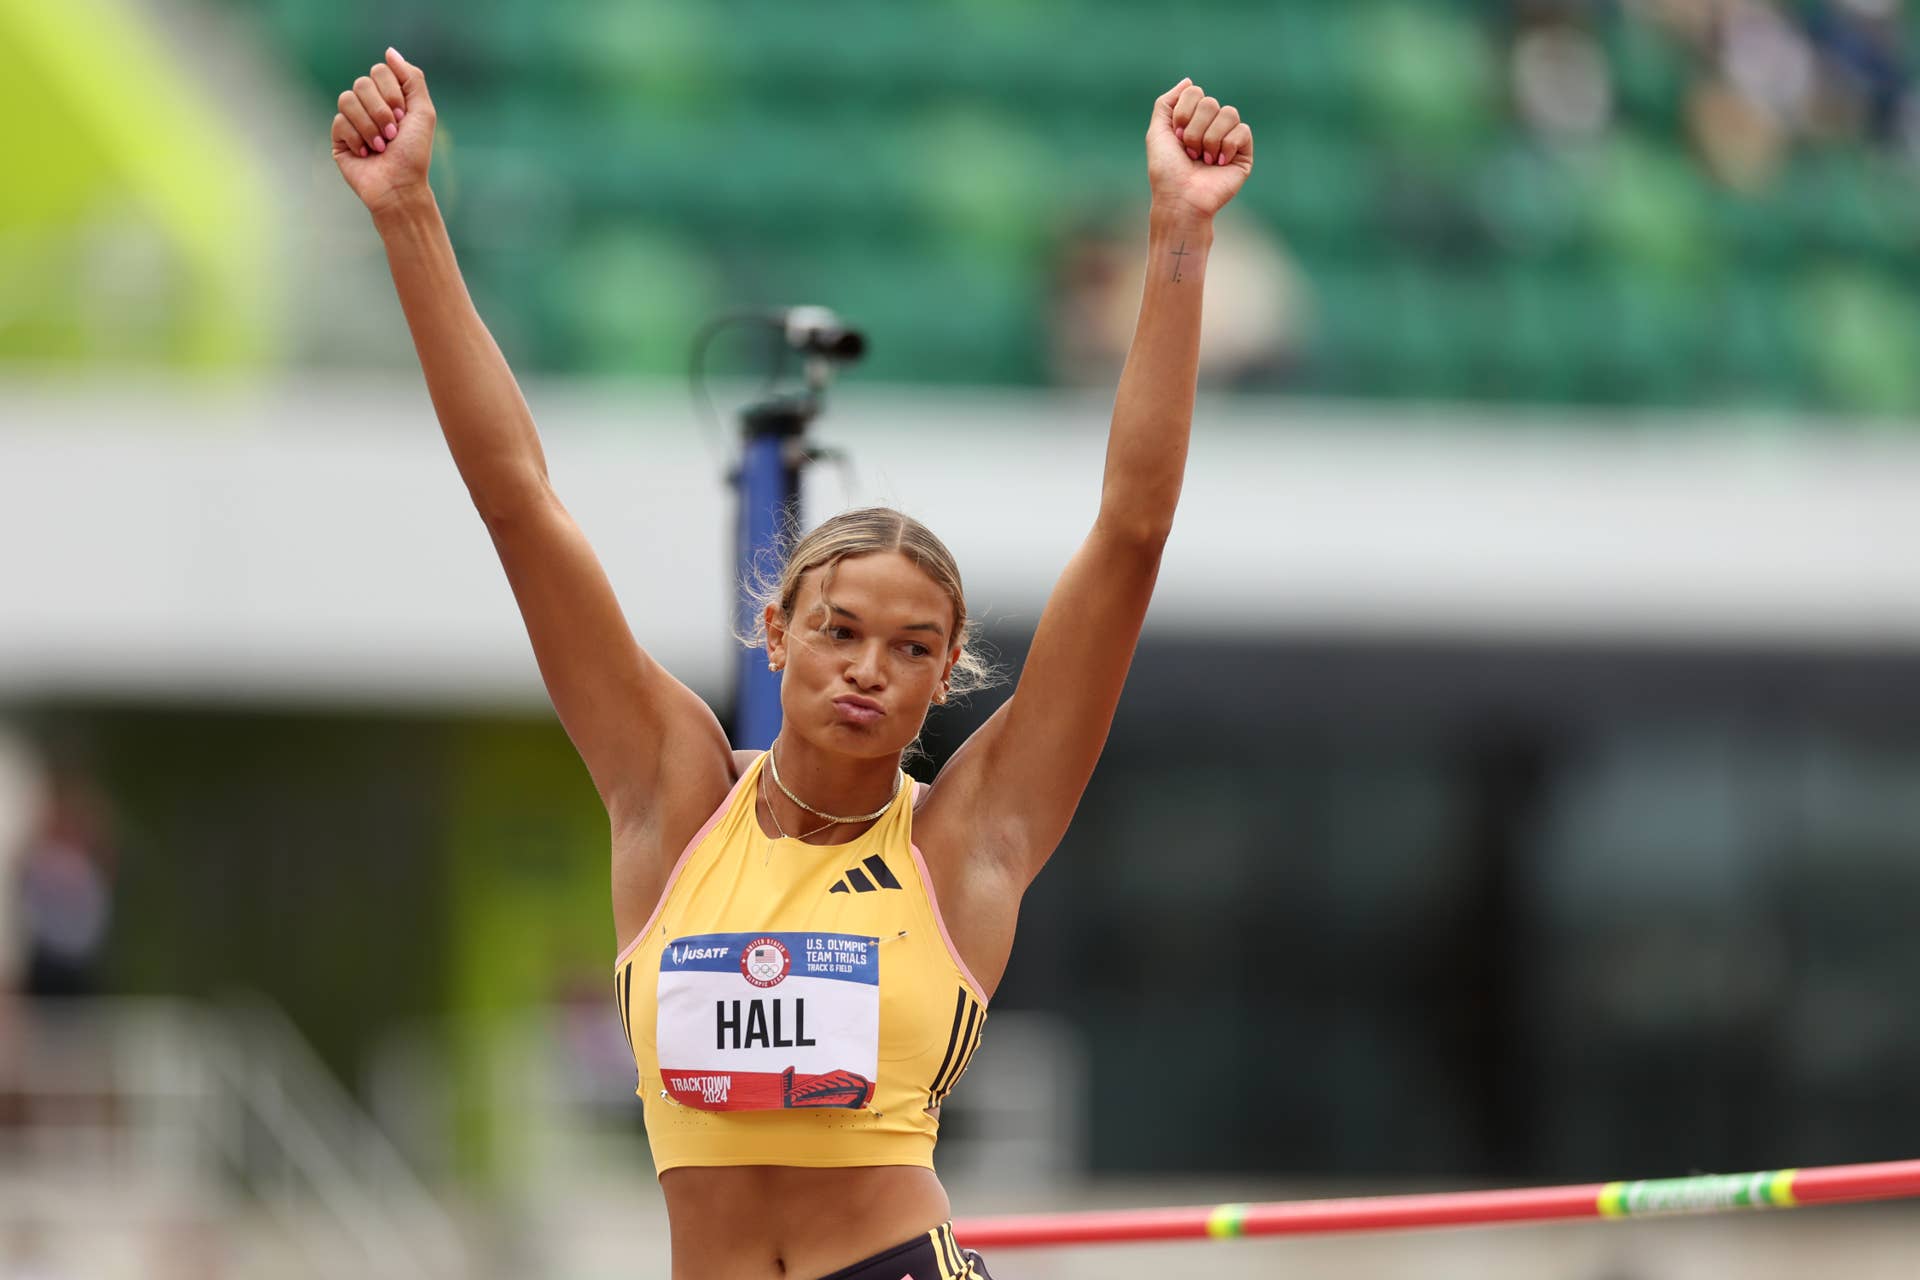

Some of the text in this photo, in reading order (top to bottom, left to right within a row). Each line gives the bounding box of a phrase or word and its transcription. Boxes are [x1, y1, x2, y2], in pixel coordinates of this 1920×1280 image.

[745, 938, 786, 953] UNITED STATES
[806, 938, 867, 953] U.S. OLYMPIC
[687, 947, 729, 960] USATF
[806, 951, 867, 965] TEAM TRIALS
[807, 963, 829, 972] TRACK
[835, 964, 853, 973] FIELD
[745, 973, 786, 988] OLYMPIC TEAM
[716, 997, 816, 1050] HALL
[702, 1088, 728, 1103] 2024
